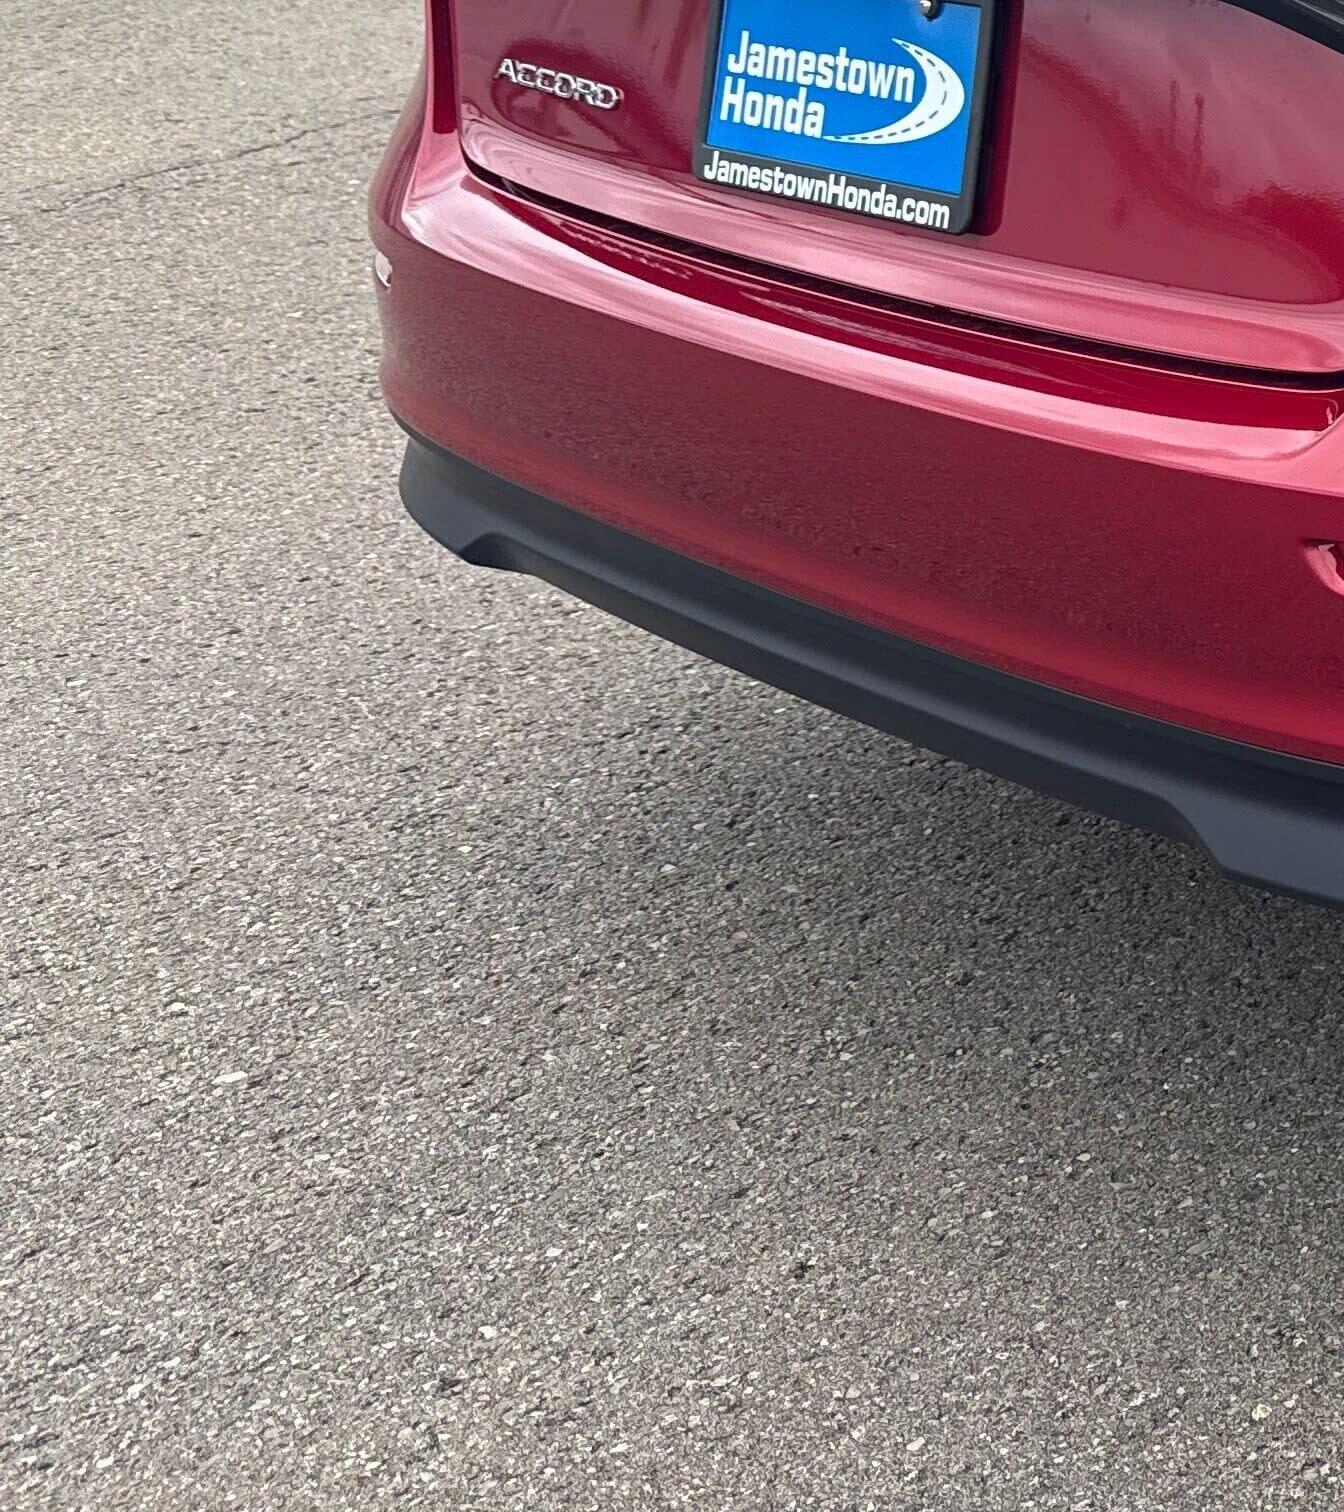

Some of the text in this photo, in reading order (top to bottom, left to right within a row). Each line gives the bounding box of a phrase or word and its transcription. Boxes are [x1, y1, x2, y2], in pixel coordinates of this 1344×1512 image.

[494, 58, 623, 109] ACCORD
[727, 30, 915, 103] Jamestown
[720, 76, 825, 138] Honda
[703, 150, 950, 229] JamestownHonda.com
